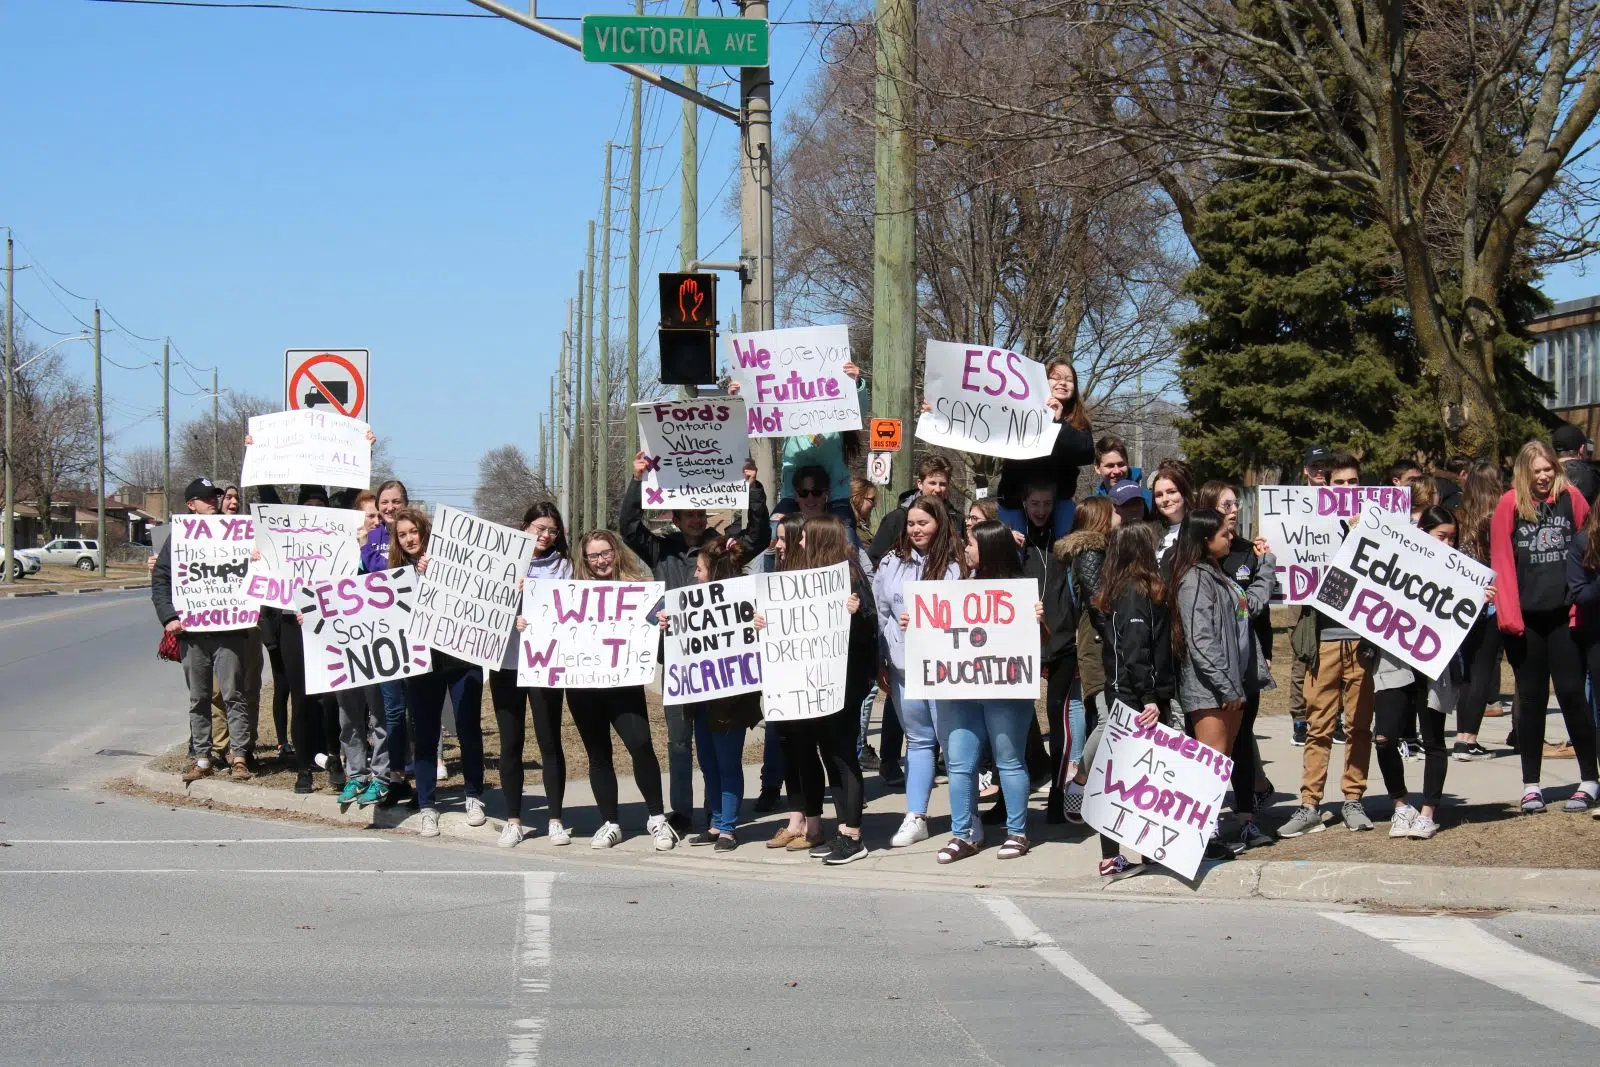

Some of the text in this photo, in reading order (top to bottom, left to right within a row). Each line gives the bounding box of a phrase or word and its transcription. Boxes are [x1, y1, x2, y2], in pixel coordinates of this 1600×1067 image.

[595, 27, 757, 55] VICTORIA AVE
[733, 339, 771, 370] We
[780, 346, 815, 366] are
[962, 350, 1030, 400] ESS
[304, 412, 325, 428] 99
[654, 403, 730, 422] Ford's
[748, 406, 784, 434] Not
[934, 397, 991, 444] SAYS
[662, 421, 722, 435] Ontario
[662, 434, 722, 452] Where
[331, 452, 360, 467] ALL
[676, 454, 734, 468] Educated
[679, 468, 725, 480] Society
[680, 481, 747, 496] Uneducated
[690, 495, 737, 507] Society
[1261, 488, 1314, 516] It's
[257, 505, 291, 528] Ford
[282, 536, 333, 561] this is
[441, 510, 532, 559] I COULDN'T
[1281, 522, 1330, 547] When
[1364, 506, 1435, 559] Someone
[1445, 553, 1493, 588] Should
[175, 544, 206, 562] this
[214, 545, 228, 558] is
[430, 534, 516, 584] THINK OF A
[1294, 549, 1330, 564] Want
[1530, 550, 1568, 563] RUGBY
[189, 558, 248, 583] Stupid
[294, 560, 317, 580] MY
[424, 557, 522, 608] CATCHY SLOGAN
[1350, 536, 1477, 630] Educate
[205, 584, 234, 594] that
[316, 572, 395, 618] ESS
[679, 583, 725, 611] OUR
[767, 568, 845, 602] EDUCATION
[186, 598, 207, 610] has
[210, 598, 227, 606] cut
[417, 582, 514, 632] B/C FORD CUT
[665, 599, 758, 637] EDUCATIO
[765, 600, 845, 636] FUELS MY
[333, 618, 390, 645] Says
[408, 609, 506, 663] MY EDUCATION
[944, 627, 988, 649] TO
[1349, 588, 1442, 662] FORD
[345, 629, 411, 683] NO!
[602, 638, 651, 668] The
[680, 631, 735, 656] WON'T
[806, 663, 836, 688] KILL
[922, 655, 1033, 686] EDUCATION
[1110, 703, 1133, 733] ALL
[1133, 748, 1176, 784] Are
[1104, 759, 1212, 830] WORTH
